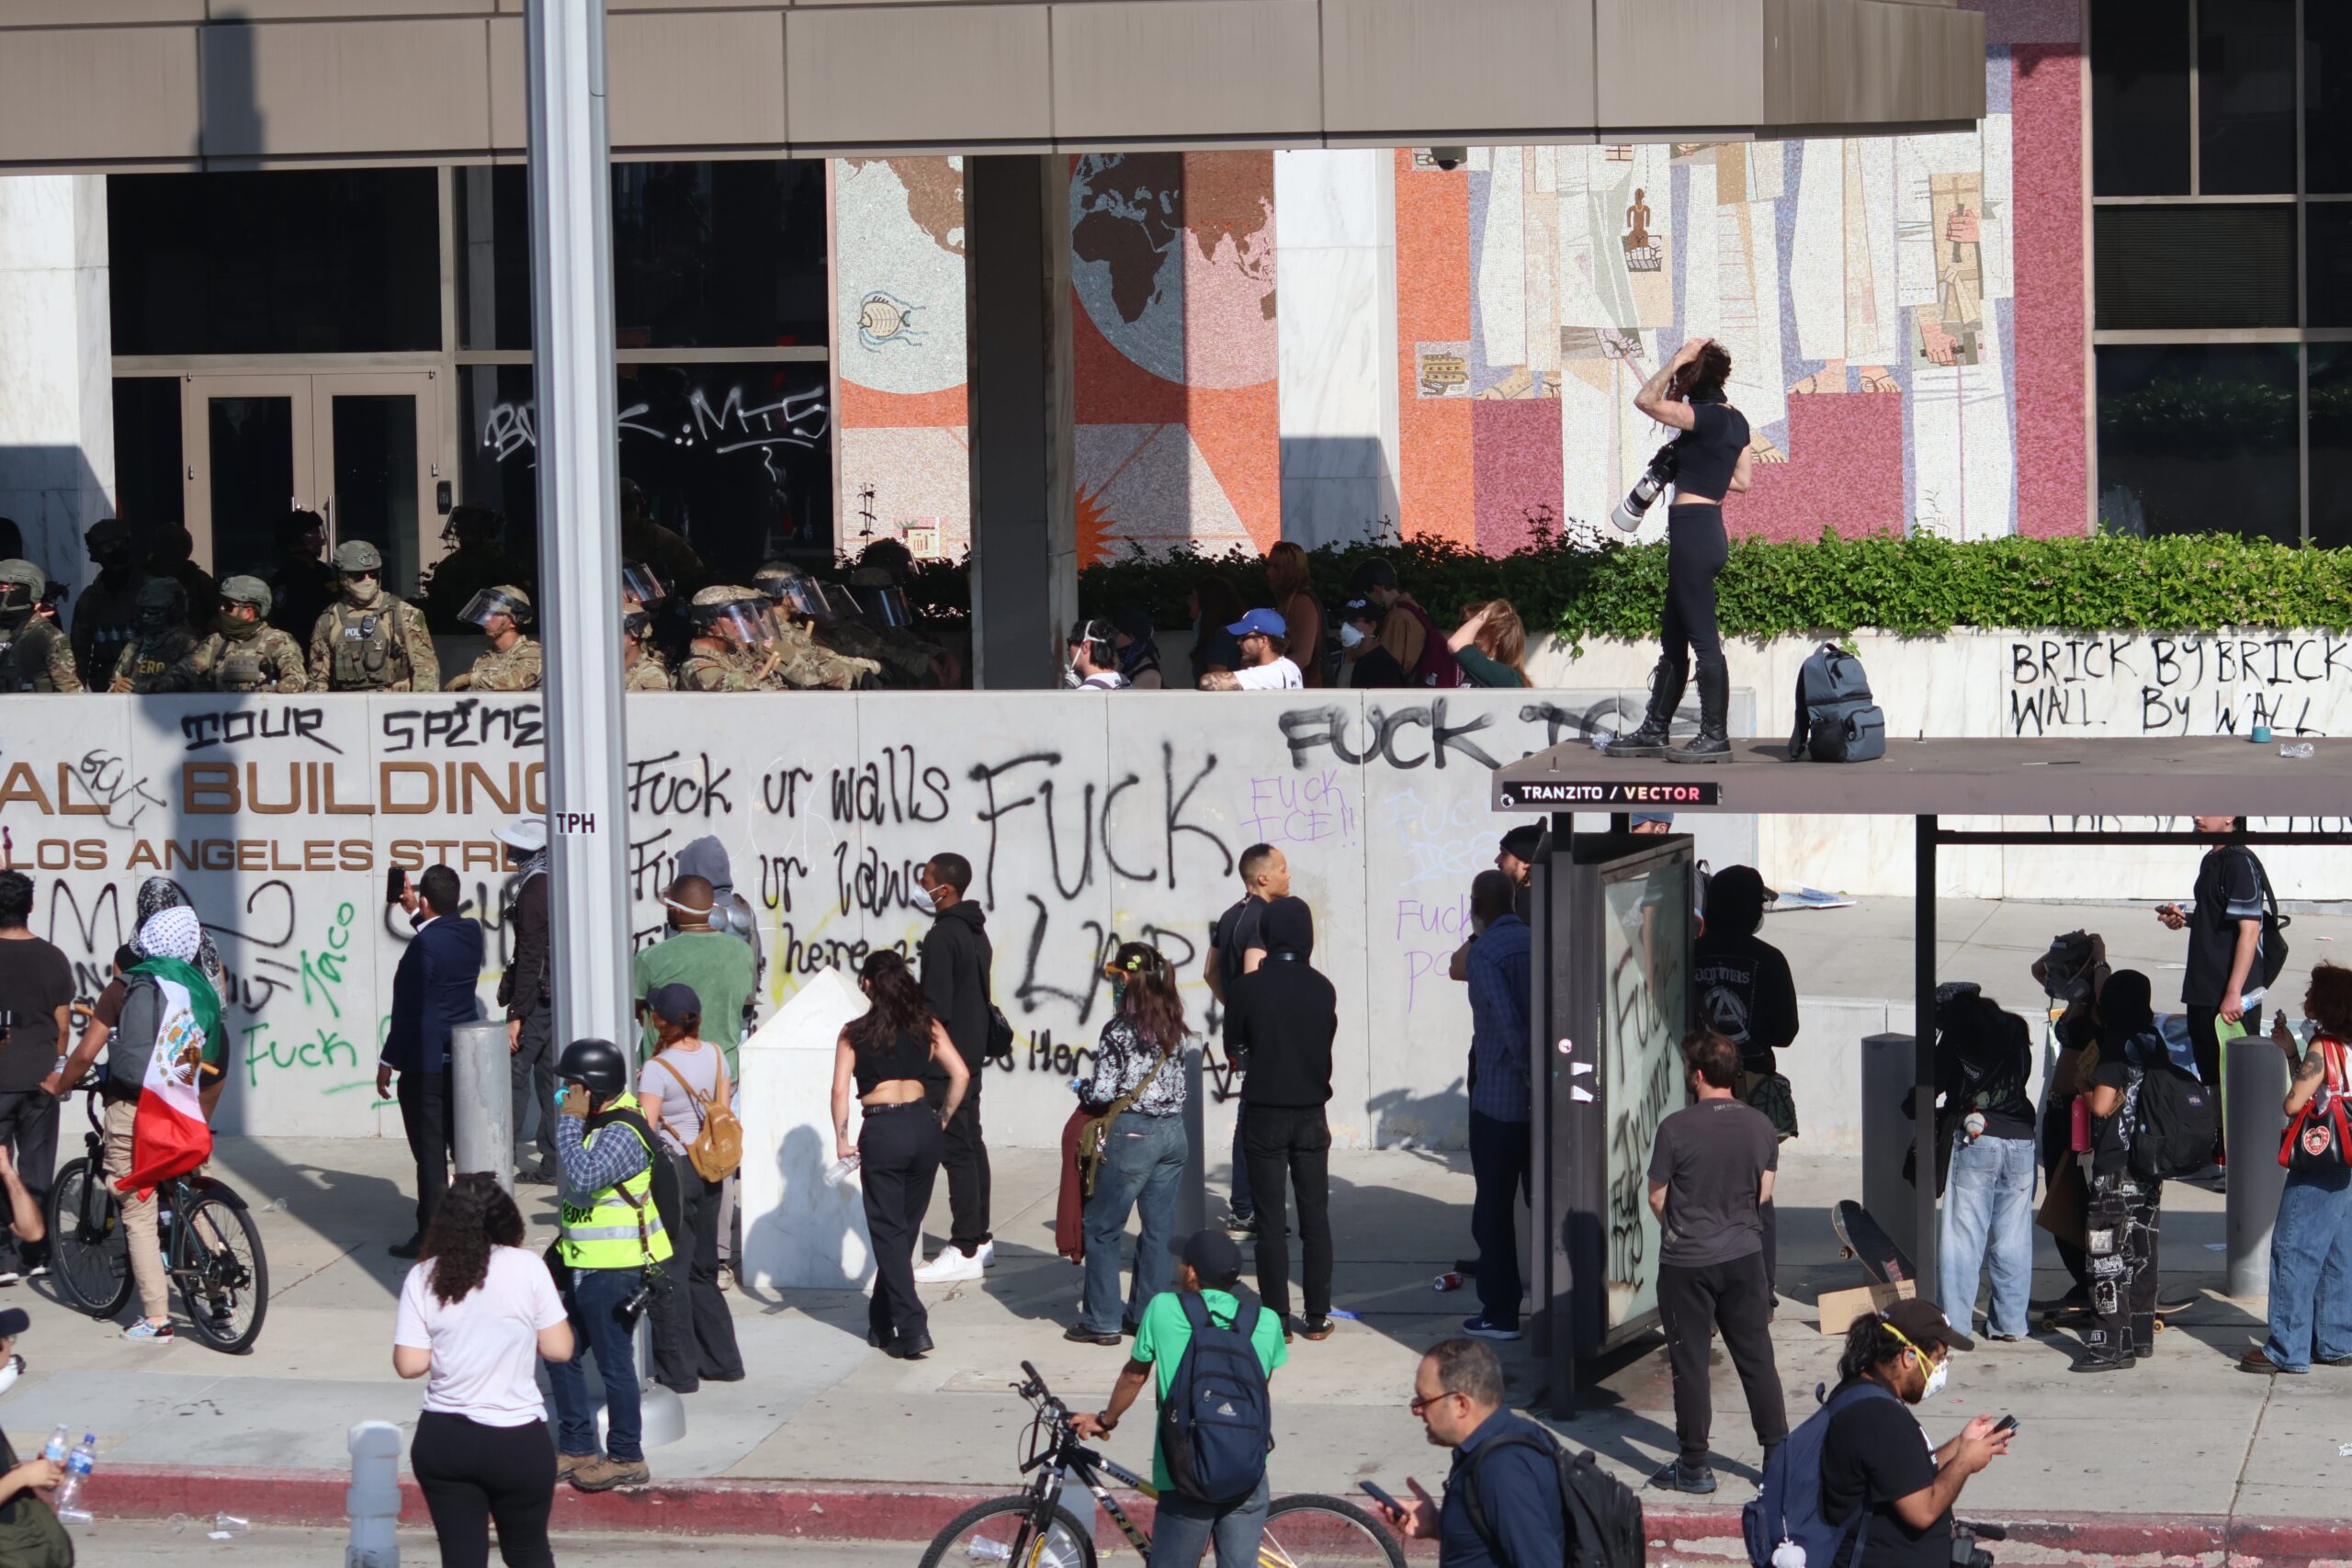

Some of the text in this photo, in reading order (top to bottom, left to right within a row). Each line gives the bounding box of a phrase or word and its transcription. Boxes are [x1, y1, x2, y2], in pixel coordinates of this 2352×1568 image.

[2012, 637, 2137, 686] BRICK
[2216, 637, 2352, 689] BRICK
[1279, 695, 1503, 771] FUCK
[2011, 686, 2107, 738] WALL
[2216, 690, 2327, 738] WALL
[0, 761, 111, 816] AL
[831, 744, 950, 826] walls
[1251, 769, 1351, 814] FUCK
[1521, 785, 1603, 800] TRANZITO
[1623, 786, 1701, 801] VECTOR
[555, 812, 596, 834] TPH
[967, 740, 1234, 912] FUCK
[1384, 787, 1493, 846] FUC
[5, 839, 107, 871] LOS
[125, 839, 374, 872] ANGELES
